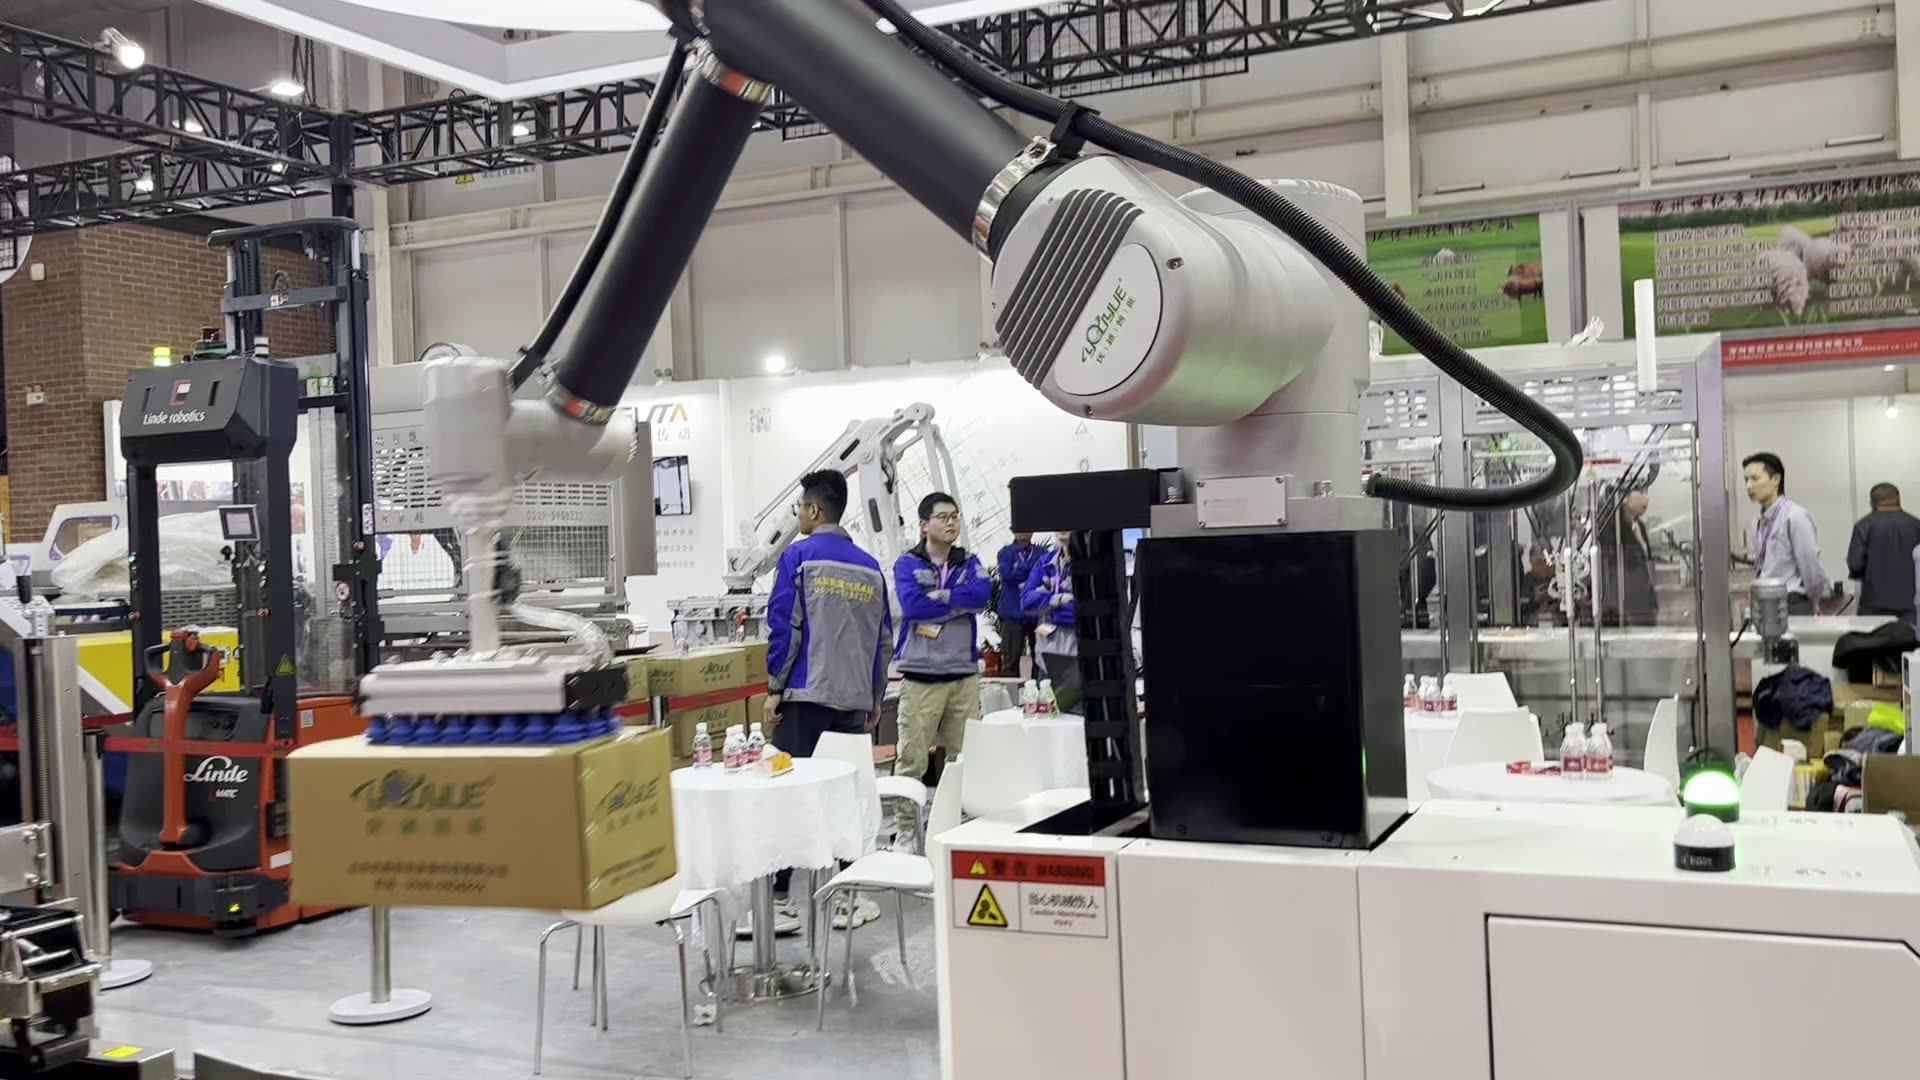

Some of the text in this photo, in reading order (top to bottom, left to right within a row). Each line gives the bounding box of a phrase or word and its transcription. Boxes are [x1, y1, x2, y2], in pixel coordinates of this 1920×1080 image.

[143, 409, 205, 425] Linde robotics
[183, 755, 249, 783] Linde
